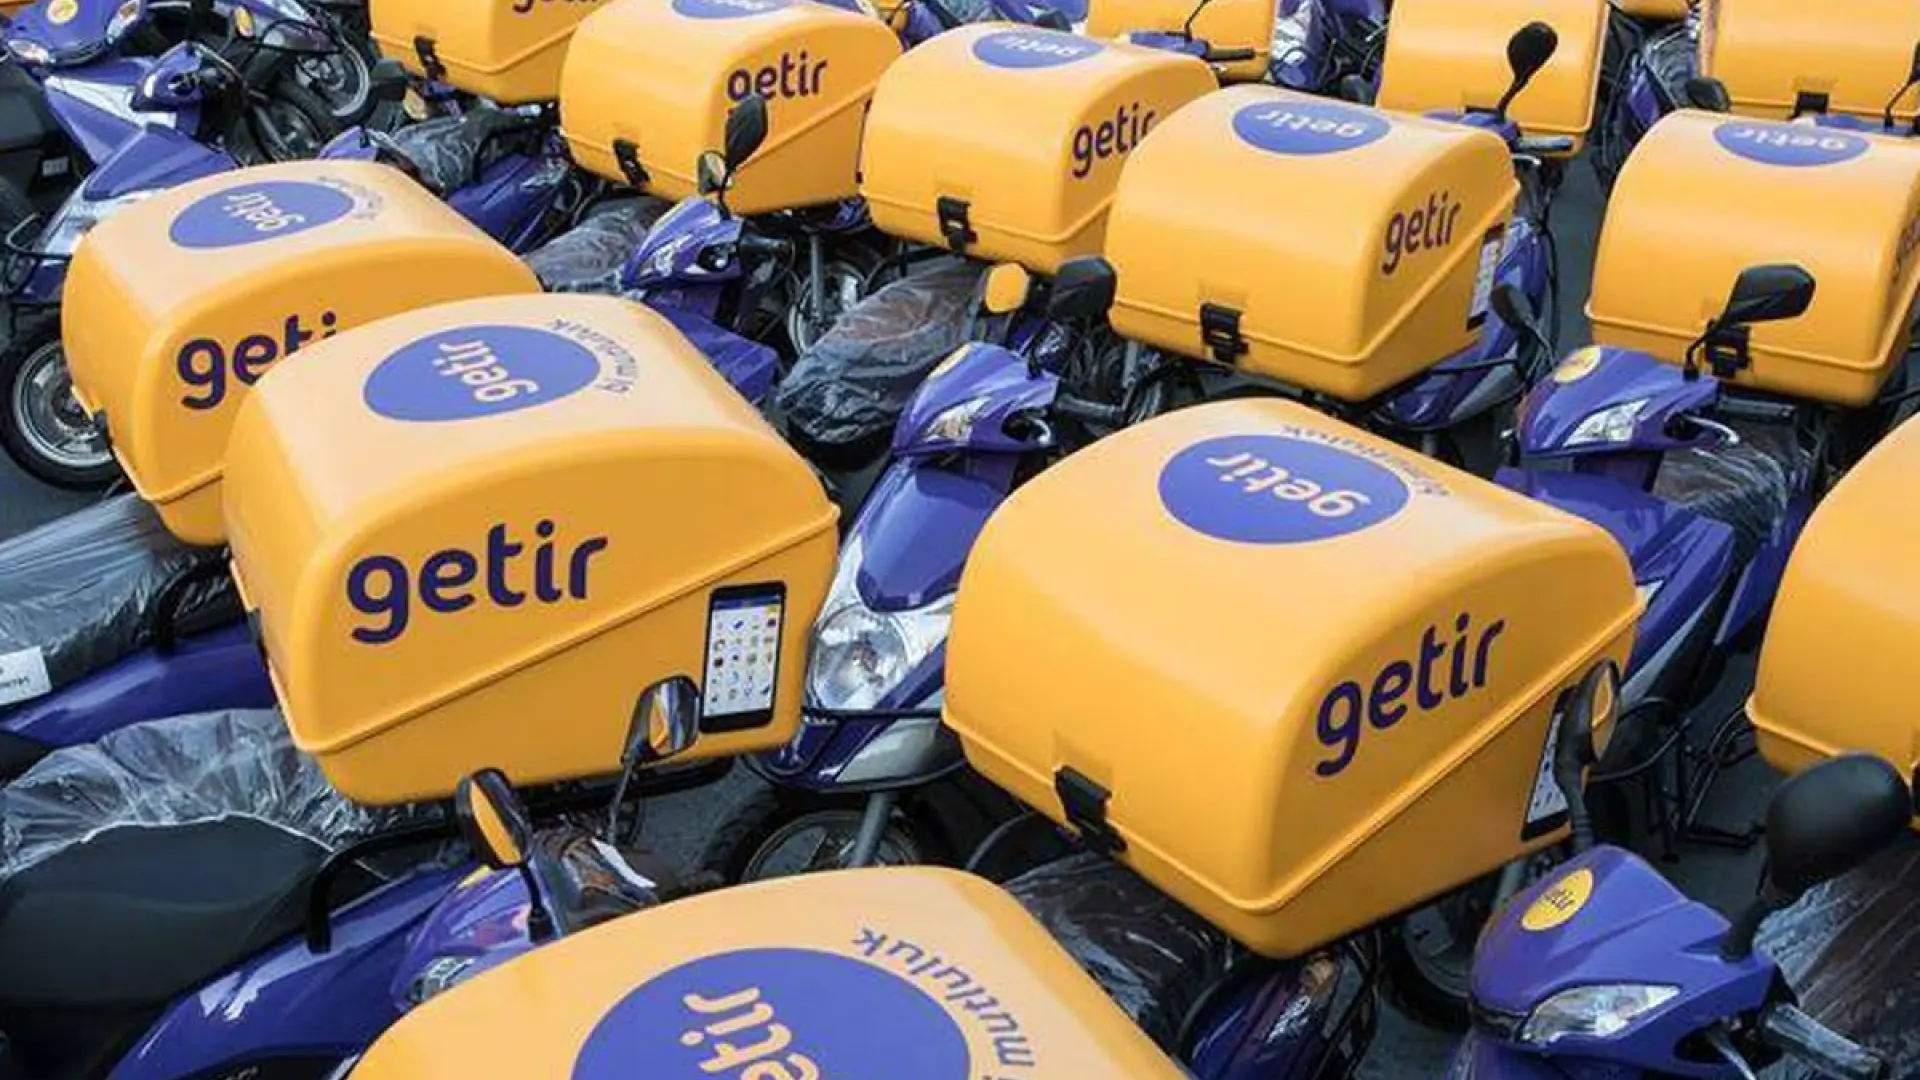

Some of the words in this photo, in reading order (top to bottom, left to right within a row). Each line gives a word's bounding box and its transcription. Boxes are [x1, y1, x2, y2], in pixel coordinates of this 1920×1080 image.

[1072, 102, 1156, 178] getir
[1382, 190, 1461, 276] getir
[177, 311, 337, 410] get
[432, 340, 540, 402] getir
[1205, 452, 1371, 517] getir
[346, 519, 609, 644] getir
[1316, 612, 1505, 776] getir
[852, 927, 1035, 1067] mutluluk
